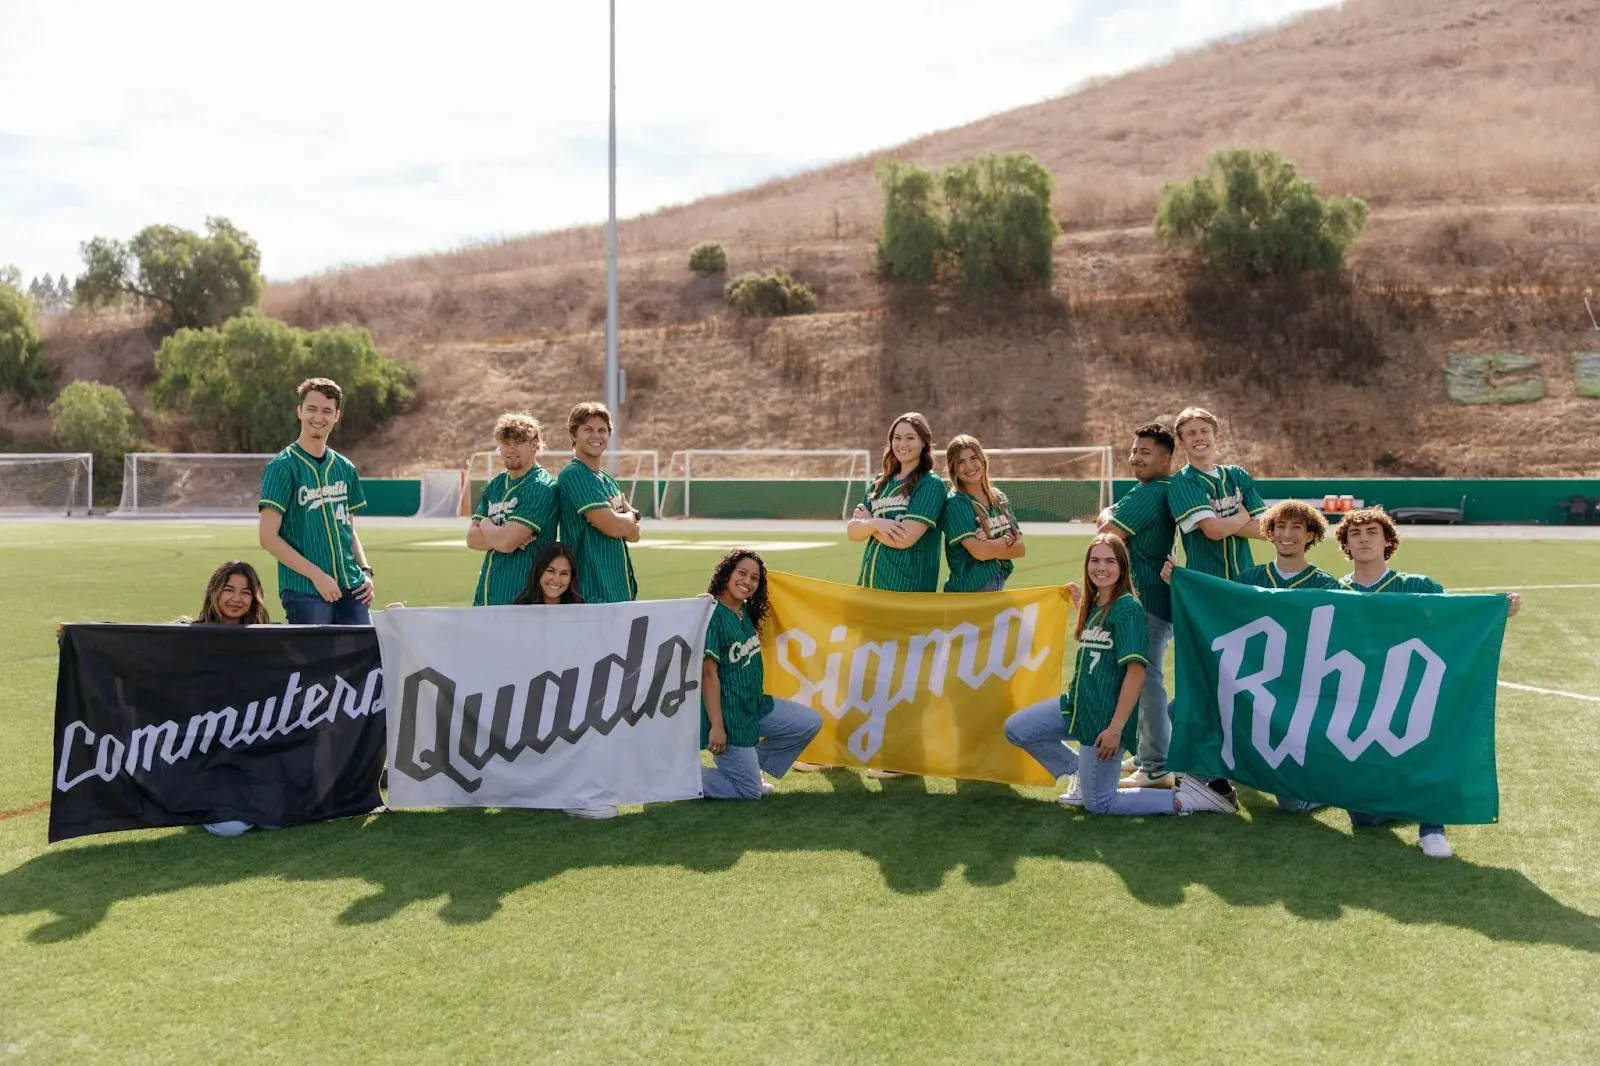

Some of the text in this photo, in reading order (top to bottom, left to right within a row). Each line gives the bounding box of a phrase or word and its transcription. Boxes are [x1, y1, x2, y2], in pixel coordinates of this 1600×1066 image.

[56, 667, 387, 793] Commuters
[395, 615, 699, 793] Quads
[776, 602, 1050, 763] Sigma
[1088, 650, 1101, 674] 7
[1211, 604, 1447, 770] Rho
